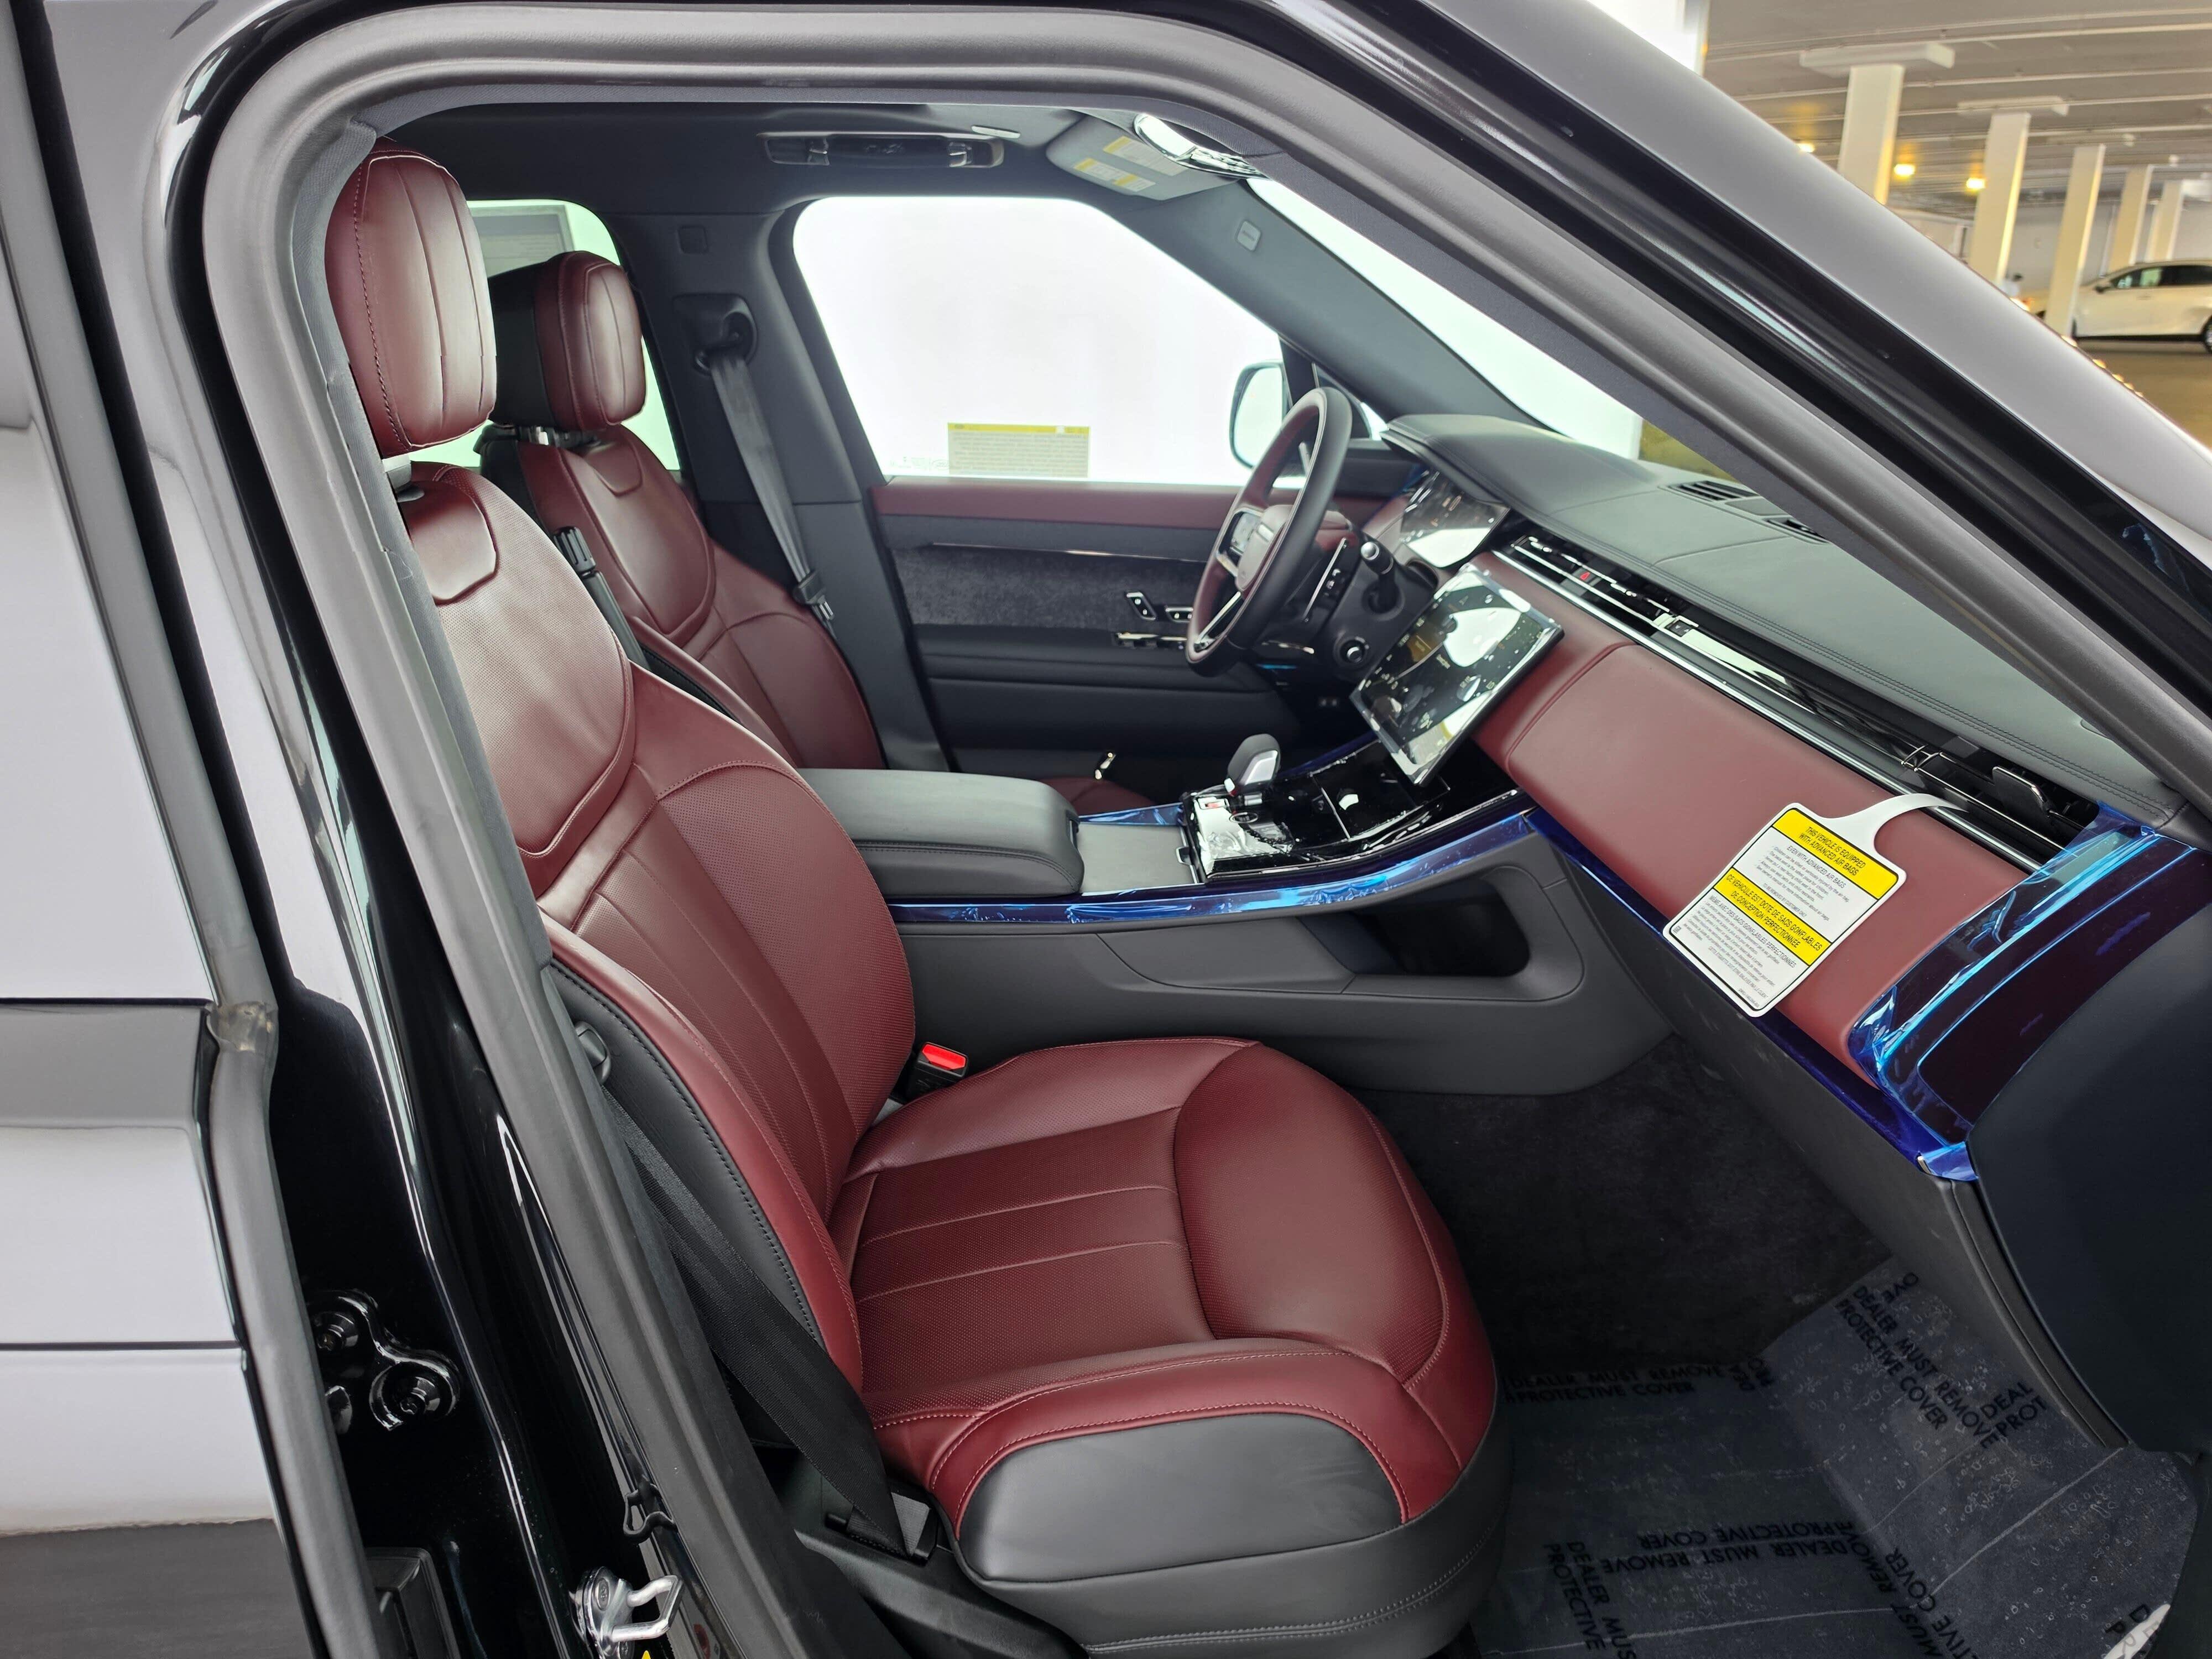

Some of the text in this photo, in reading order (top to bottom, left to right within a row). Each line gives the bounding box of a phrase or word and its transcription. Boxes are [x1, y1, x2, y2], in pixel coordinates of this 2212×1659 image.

[1787, 845, 1846, 889] EVEN WITH ADVANCED AIR BAGS
[1798, 832, 1859, 876] WITH ADVANCED AIR BAGS
[1805, 826, 1818, 837] THIS
[1814, 833, 1837, 849] VEHICLE
[1839, 849, 1866, 869] EQUIPPED
[1725, 873, 1735, 883] CE
[1750, 893, 1762, 904] EST
[1770, 909, 1781, 918] DE
[1777, 914, 1793, 928] SACS
[1789, 924, 1823, 951] GONFLABLES
[1730, 890, 1740, 899] DE
[1736, 895, 1765, 920] CONCEPTION
[1733, 915, 1744, 924] SACS
[1742, 922, 1768, 944] GONFLABLES
[1588, 1370, 1639, 1384] MUST
[1834, 1298, 1948, 1430] PROTECTIVE COVER
[1854, 1285, 1999, 1449] DEALER MUST REMOVE
[1516, 1381, 1695, 1403] PROTECTIVE COVER
[1981, 1383, 2033, 1419] DEAL
[1995, 1395, 2047, 1438] PROT
[1638, 1522, 1837, 1549] PROTECTIVE COVER
[1567, 1541, 1610, 1605] DEALER
[1603, 1541, 1848, 1574] DEALER MUST REMOVE
[1543, 1543, 1606, 1650] PROTECTIVE
[1834, 1521, 1943, 1657] MUST REMOVE
[1885, 1548, 1936, 1611] COVER
